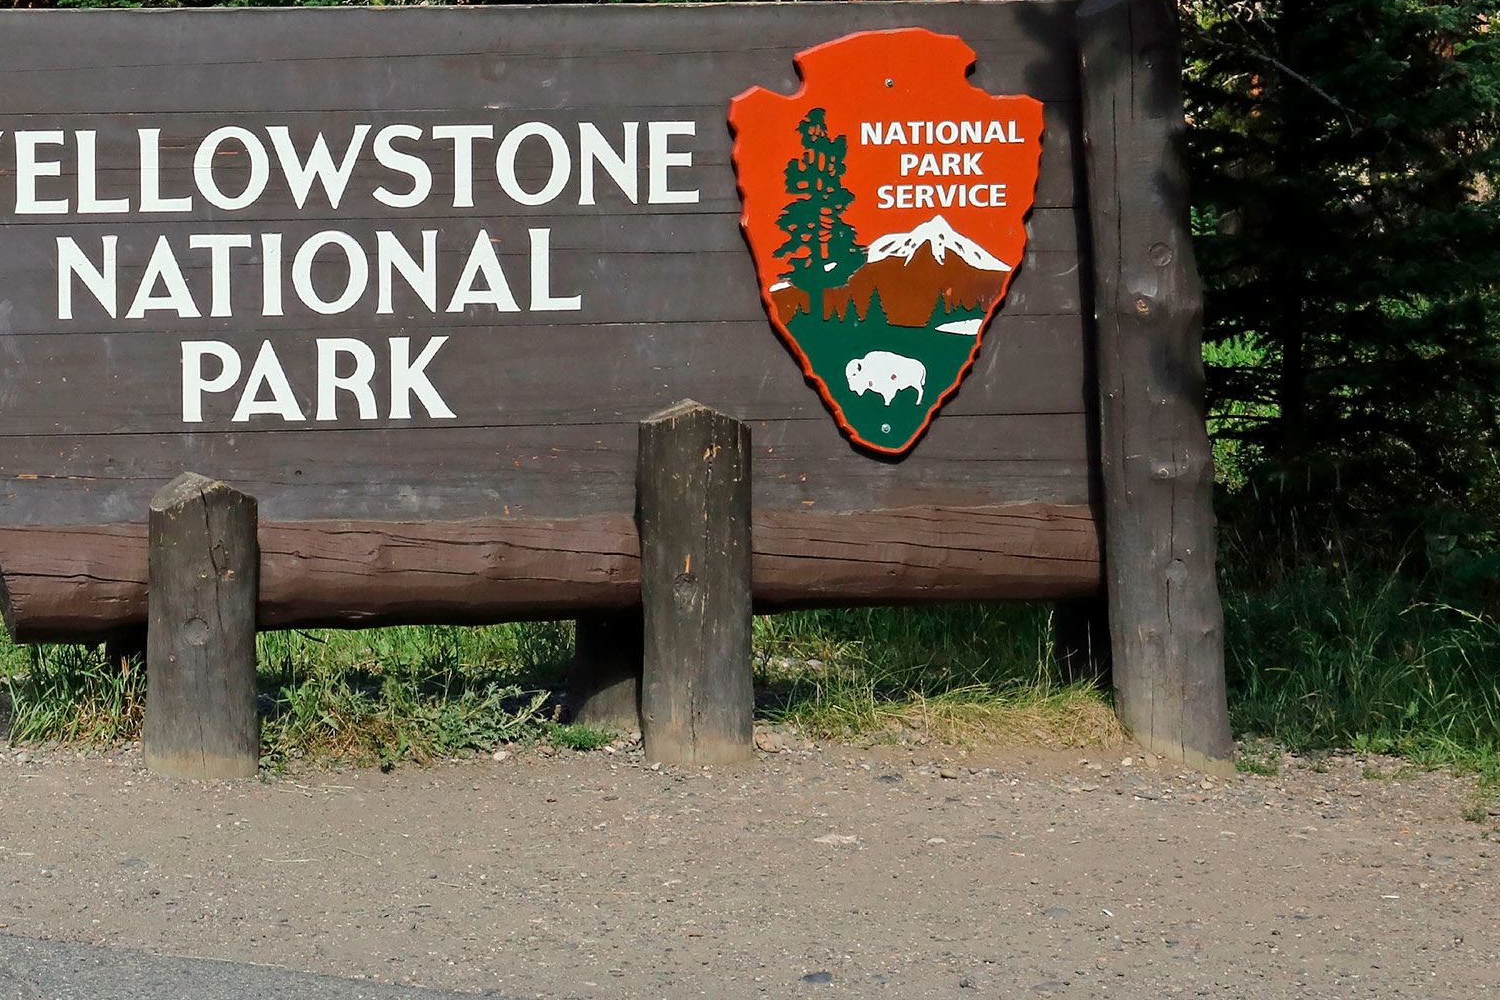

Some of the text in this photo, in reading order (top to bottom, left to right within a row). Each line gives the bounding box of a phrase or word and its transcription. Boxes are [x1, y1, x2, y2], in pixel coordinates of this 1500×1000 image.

[860, 120, 1025, 145] NATIONAL
[900, 152, 984, 176] PARK
[877, 184, 1007, 208] SERVICE
[56, 228, 582, 319] NATIONAL
[180, 335, 458, 422] PARK
